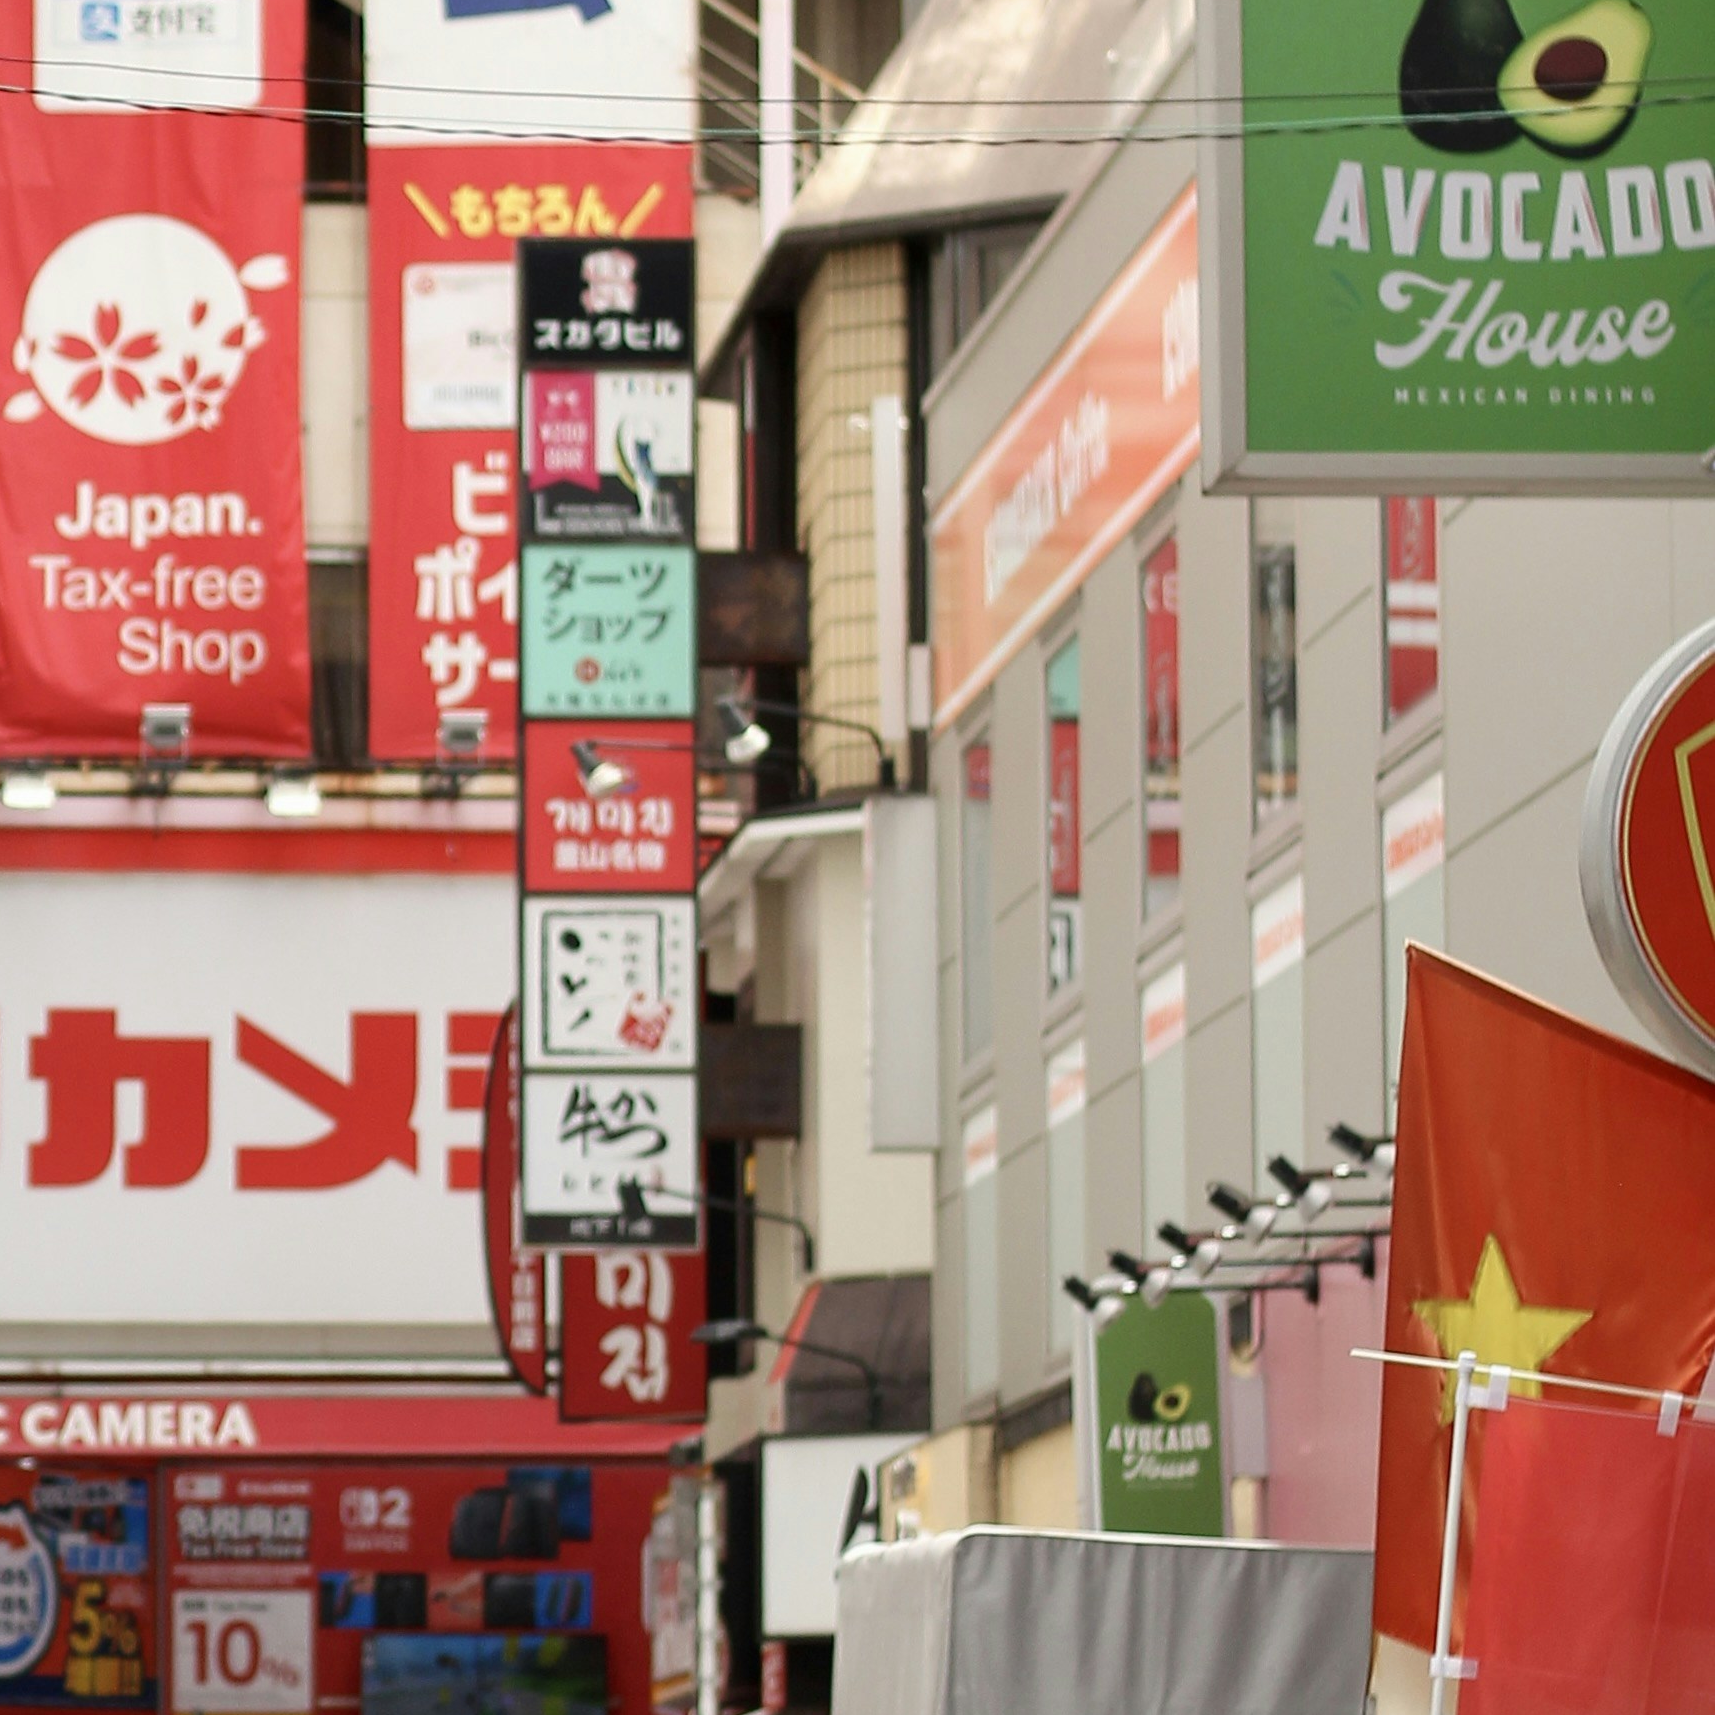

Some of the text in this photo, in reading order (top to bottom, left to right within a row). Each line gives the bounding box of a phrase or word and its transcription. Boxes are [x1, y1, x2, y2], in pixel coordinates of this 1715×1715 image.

[450, 182, 616, 239] もちろん
[1313, 157, 1715, 262] AVOCADO
[1374, 269, 1676, 371] House
[1394, 387, 1657, 407] MEXICAN DINING
[54, 479, 263, 549] Japan.
[28, 552, 266, 612] Tax-free
[543, 558, 669, 601] ダーツ
[116, 619, 266, 684] Shop
[542, 608, 672, 645] ショップ
[20, 1401, 259, 1449] CAMERA
